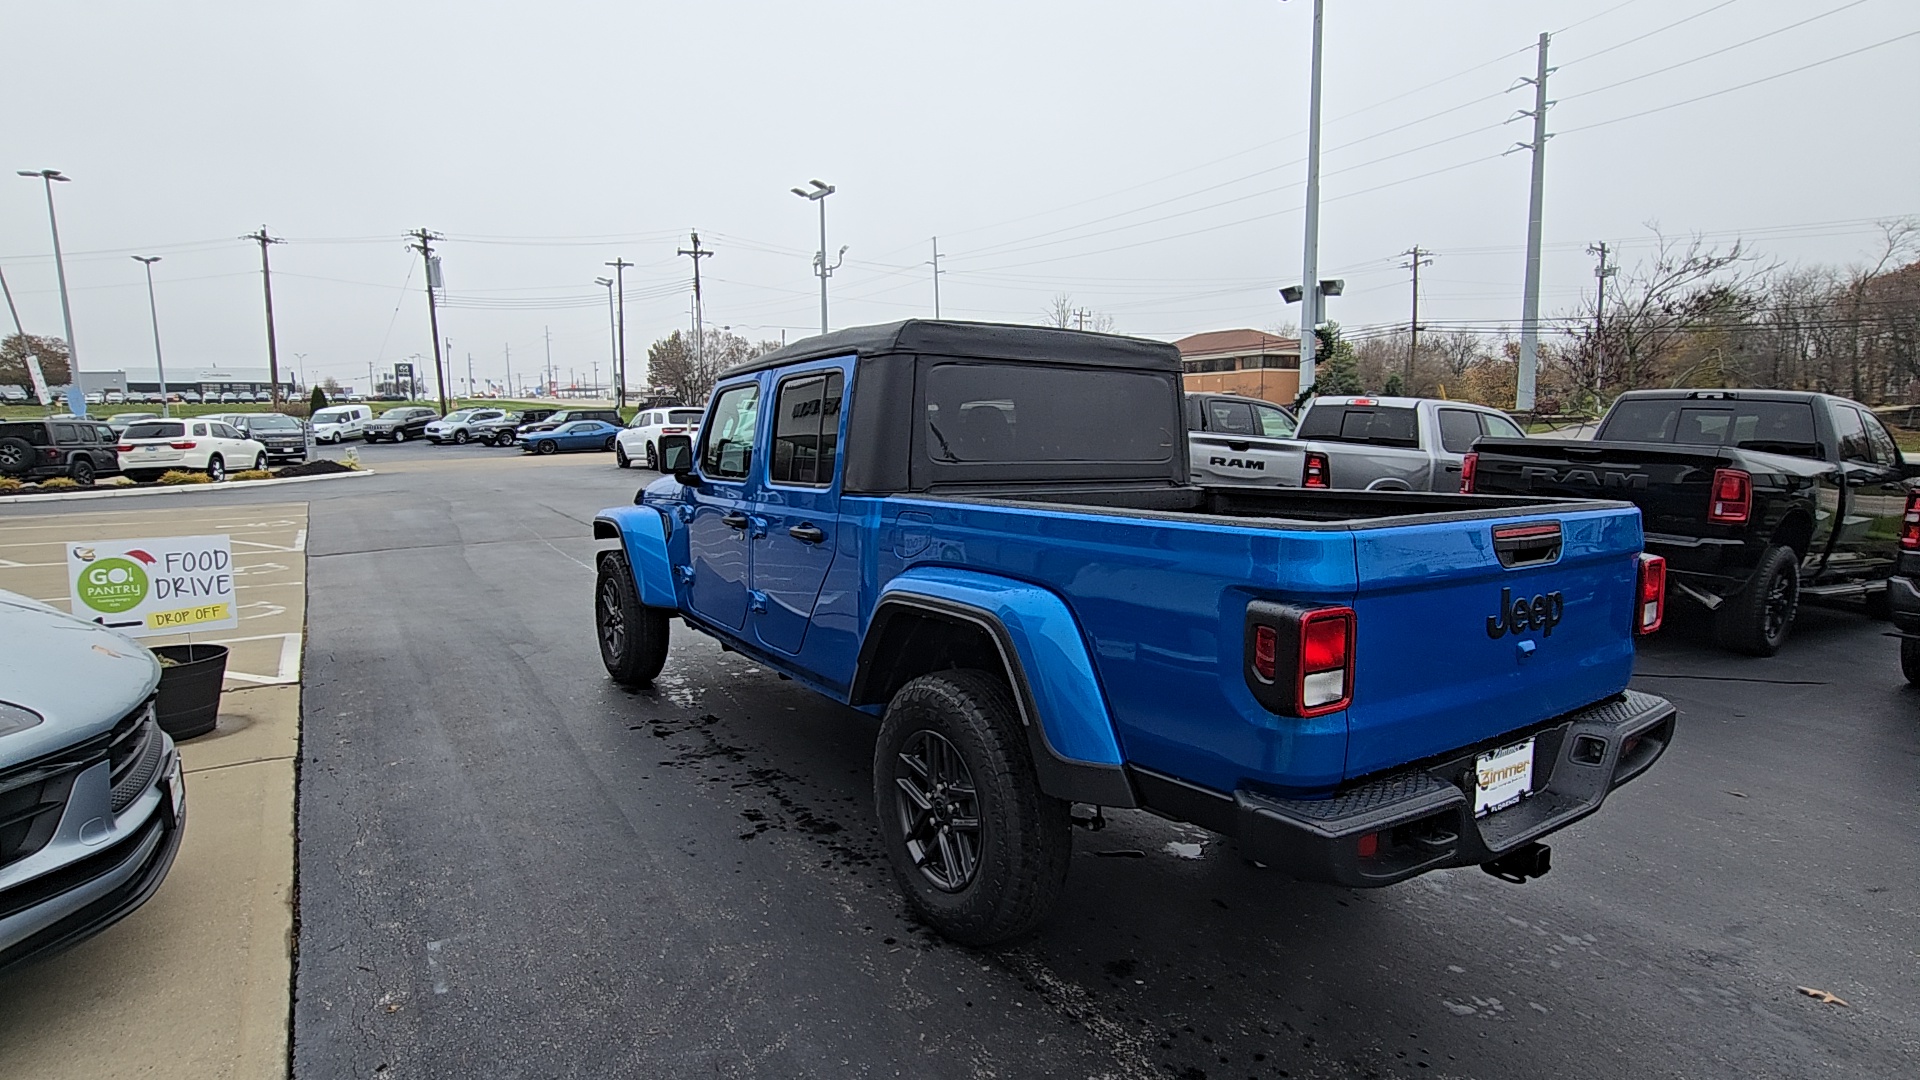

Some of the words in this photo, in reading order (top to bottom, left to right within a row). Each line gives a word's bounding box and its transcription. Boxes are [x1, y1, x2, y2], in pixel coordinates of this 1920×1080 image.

[1209, 456, 1265, 470] RAM
[1520, 466, 1649, 489] RAM
[165, 549, 228, 573] FOOD
[89, 567, 134, 585] GO!
[155, 574, 231, 600] DRIVE
[87, 584, 141, 596] PANTRY
[155, 611, 190, 626] DROP
[195, 605, 221, 620] OFF
[1486, 586, 1564, 640] Jeep
